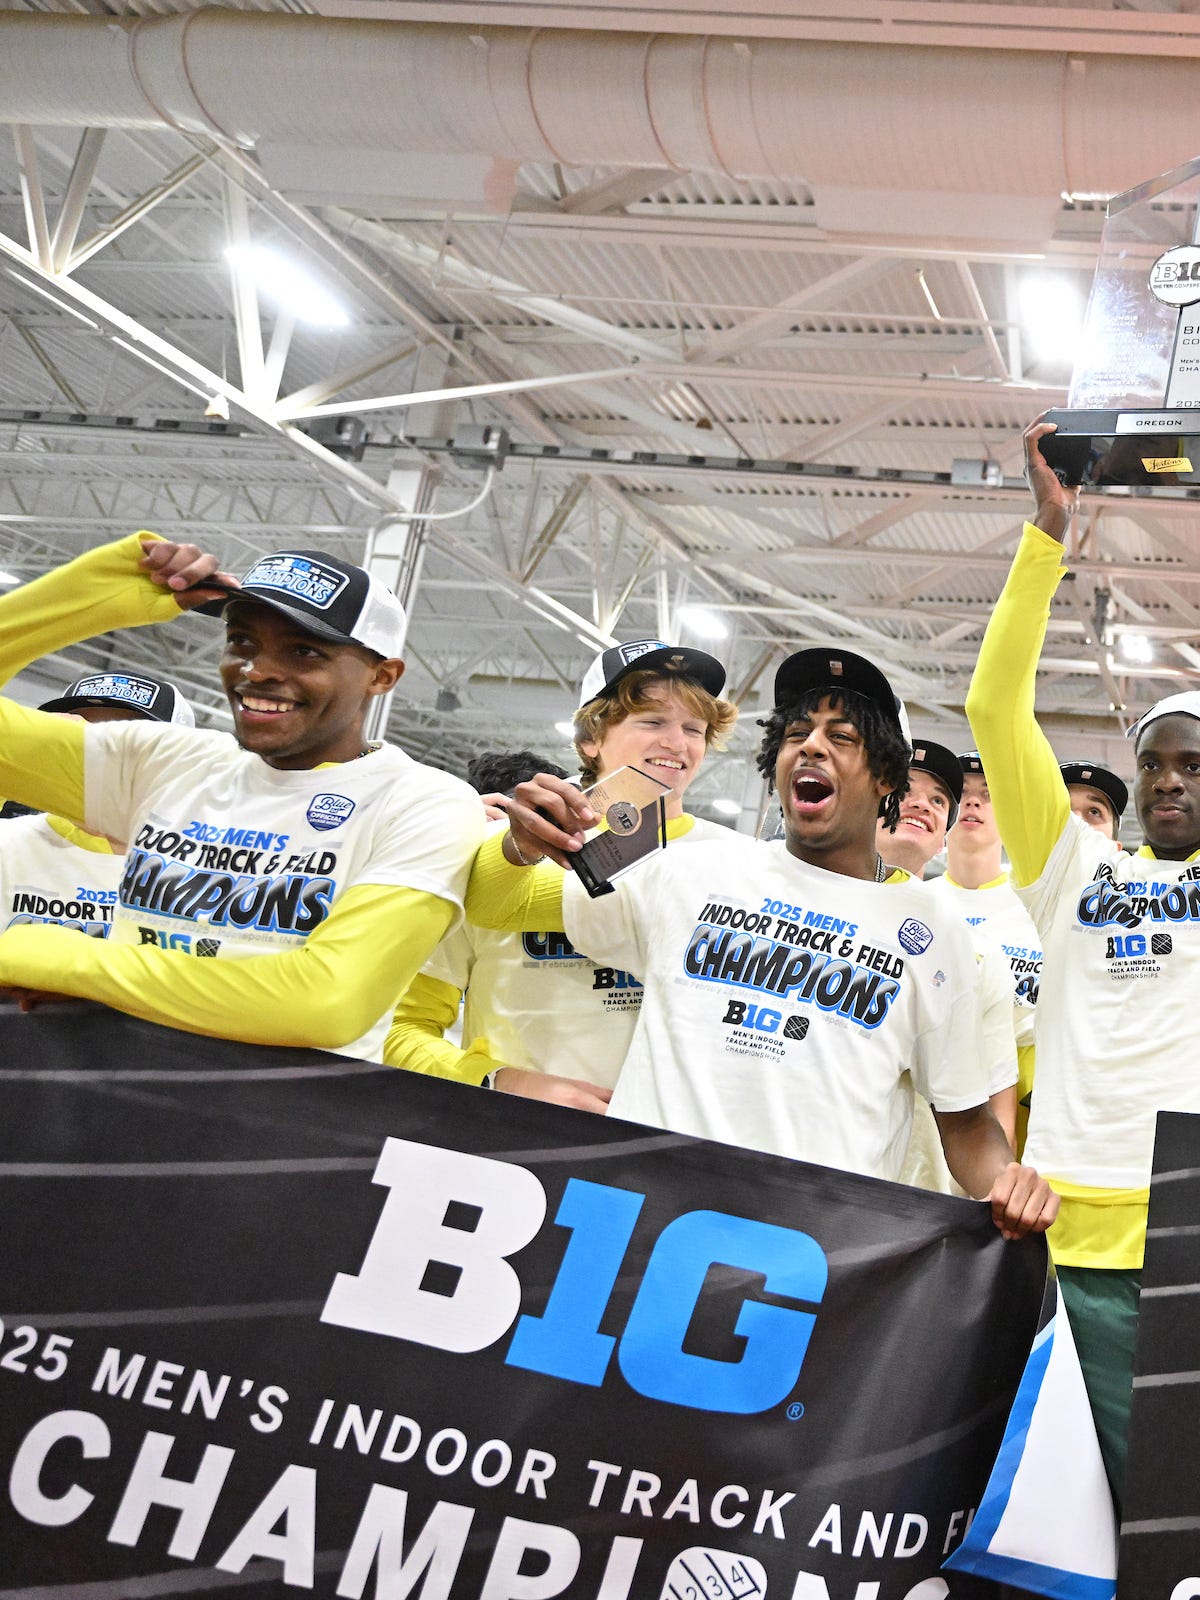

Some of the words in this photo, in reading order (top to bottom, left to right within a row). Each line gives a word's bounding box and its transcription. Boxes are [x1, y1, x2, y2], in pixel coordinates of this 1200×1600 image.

[314, 796, 351, 810] Blue
[310, 812, 342, 823] OFFICIAL
[221, 828, 290, 852] MEN'S
[195, 844, 263, 874] TRACK
[263, 855, 280, 875] &
[12, 893, 96, 920] INDOOR
[76, 887, 119, 904] 2025
[760, 898, 802, 922] 2025
[803, 911, 859, 938] MEN'S
[698, 903, 773, 935] INDOOR
[774, 920, 838, 954] TRACK
[838, 939, 854, 958] &
[856, 945, 905, 979] FIELD
[904, 922, 931, 941] Blue
[683, 923, 901, 1030] CHAMPIONS
[1010, 957, 1043, 974] TRAC
[725, 1036, 749, 1047] TRACK
[749, 1042, 763, 1050] AND
[764, 1045, 786, 1056] FIELD
[732, 1030, 754, 1040] MEN'S
[754, 1034, 784, 1047] INDOOR
[725, 1045, 781, 1063] CHAMPIONSHIPS
[92, 1347, 290, 1433] MEN'S
[310, 1399, 557, 1500] INDOOR
[587, 1460, 796, 1539] TRACK
[811, 1504, 928, 1560] AND
[706, 1575, 723, 1597] 3
[731, 1565, 745, 1586] 4
